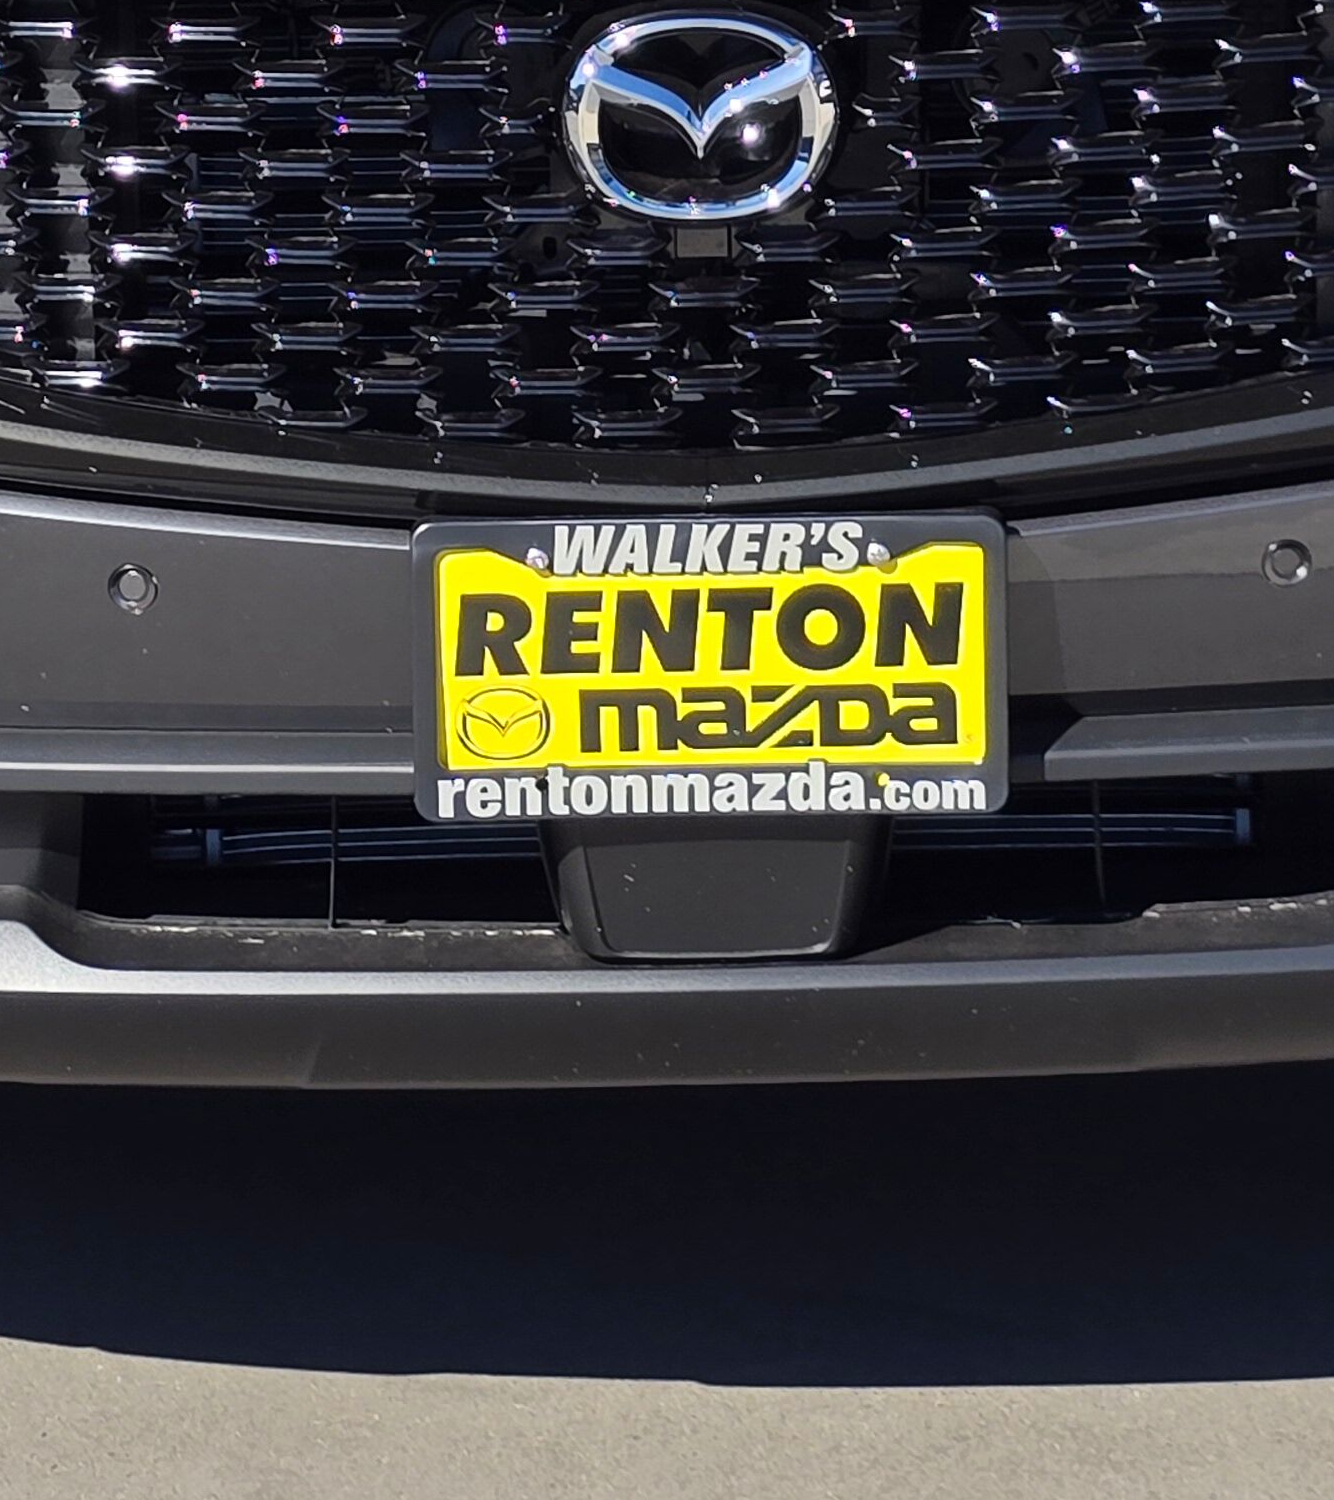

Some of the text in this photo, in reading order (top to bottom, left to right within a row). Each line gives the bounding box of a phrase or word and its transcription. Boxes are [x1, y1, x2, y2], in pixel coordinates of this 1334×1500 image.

[553, 521, 863, 575] WALKER'S
[454, 582, 964, 677] RENTON
[579, 682, 959, 753] mazda
[436, 762, 987, 819] rentonmazda.com
